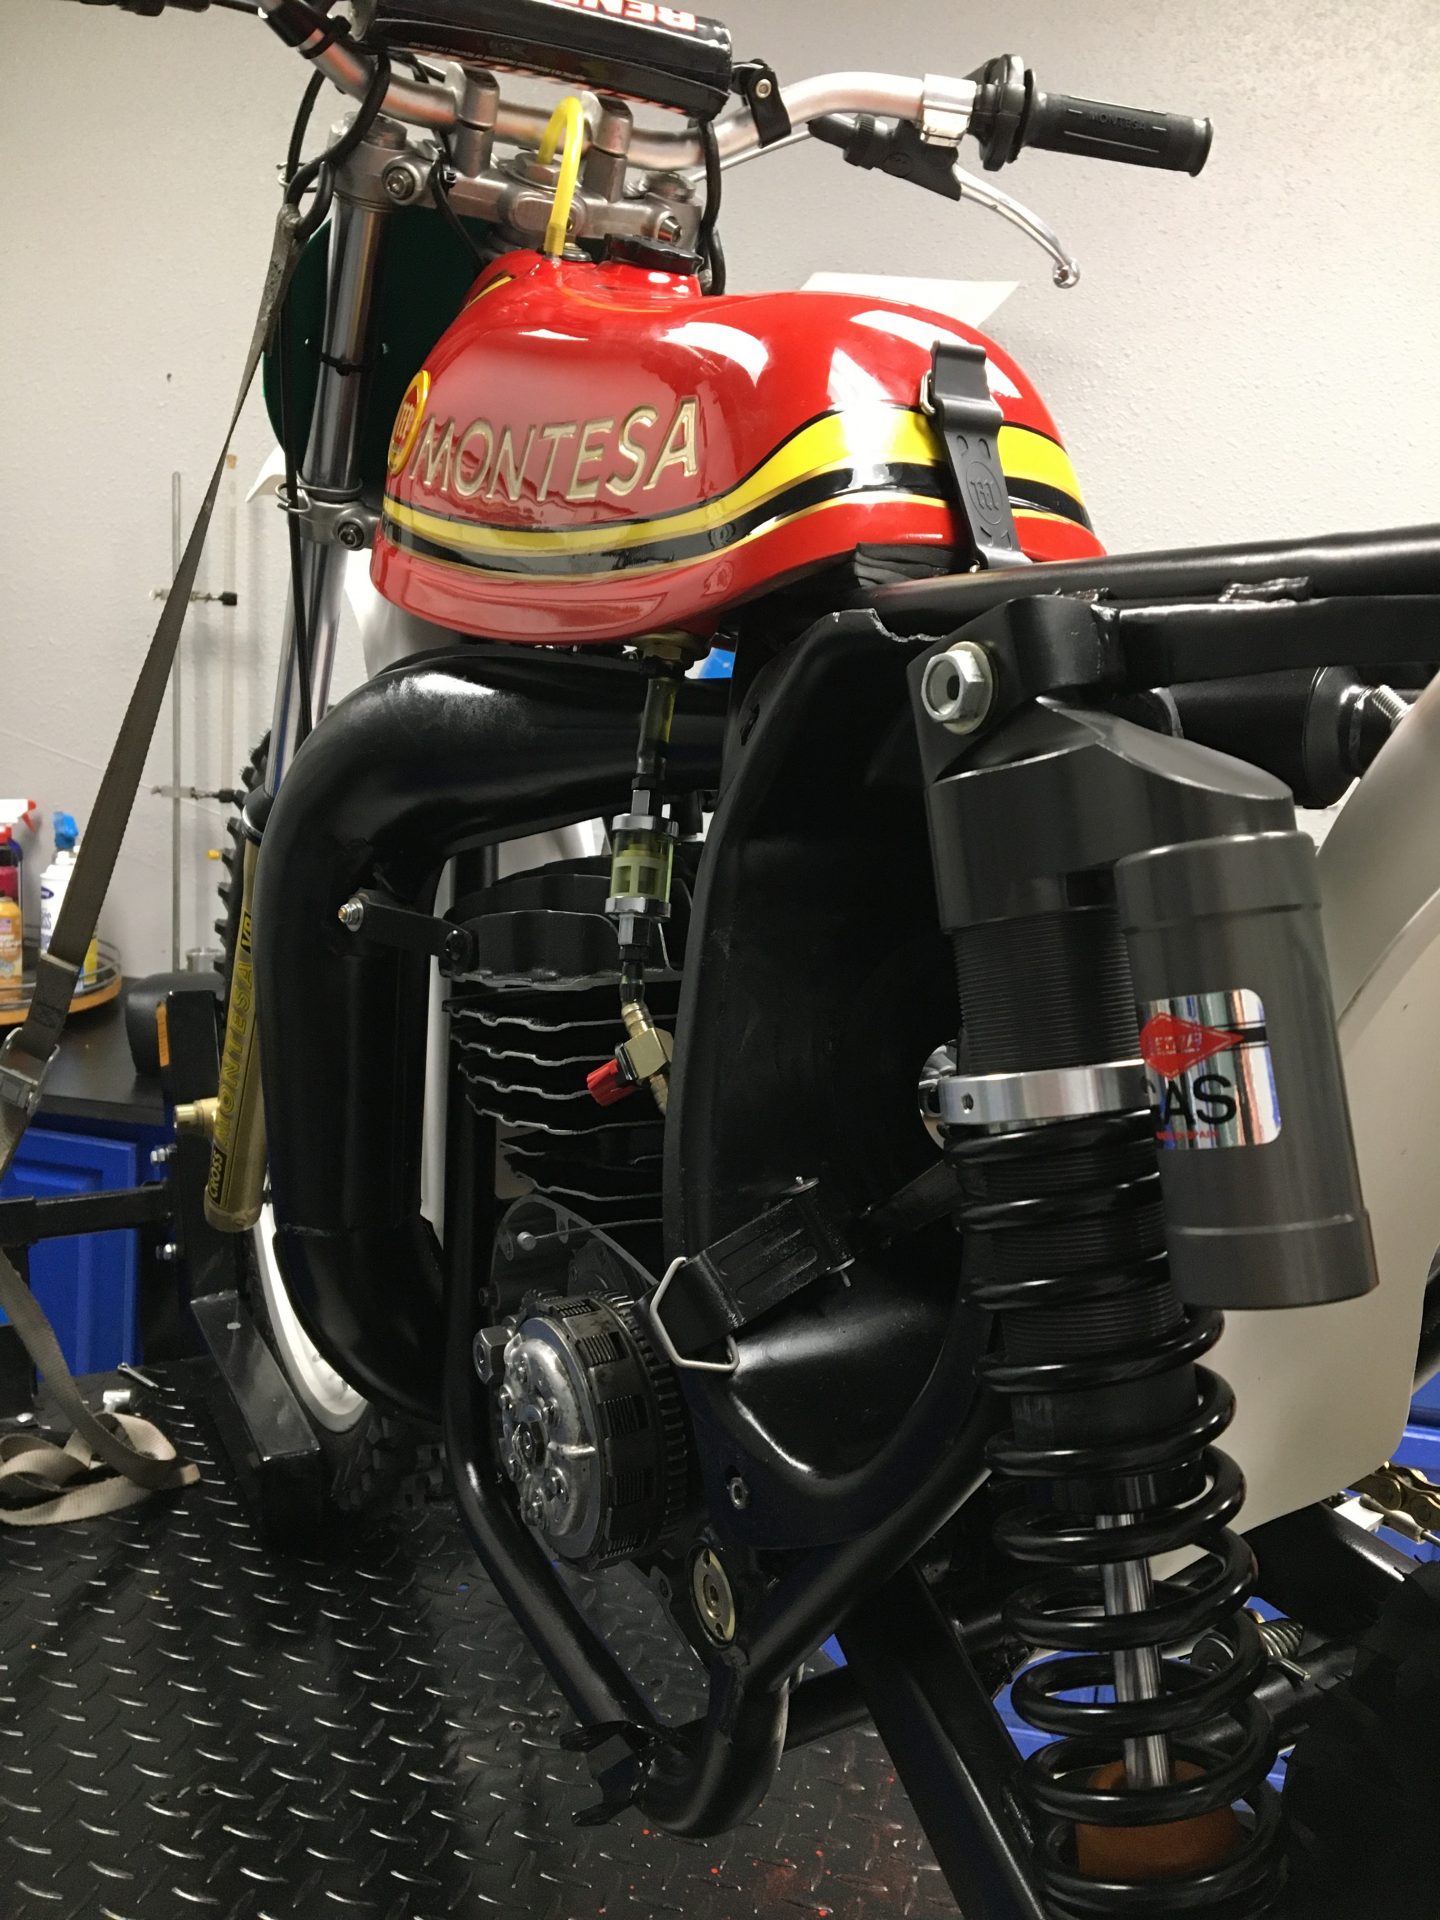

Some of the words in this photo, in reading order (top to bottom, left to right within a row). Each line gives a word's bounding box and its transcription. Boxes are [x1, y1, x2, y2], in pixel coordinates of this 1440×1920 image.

[549, 0, 697, 31] REN
[1089, 112, 1146, 132] MONTESA
[409, 395, 701, 501] MONTESA
[214, 961, 253, 1147] MONTESA
[1141, 1073, 1238, 1127] AS
[208, 1150, 224, 1198] CROSS
